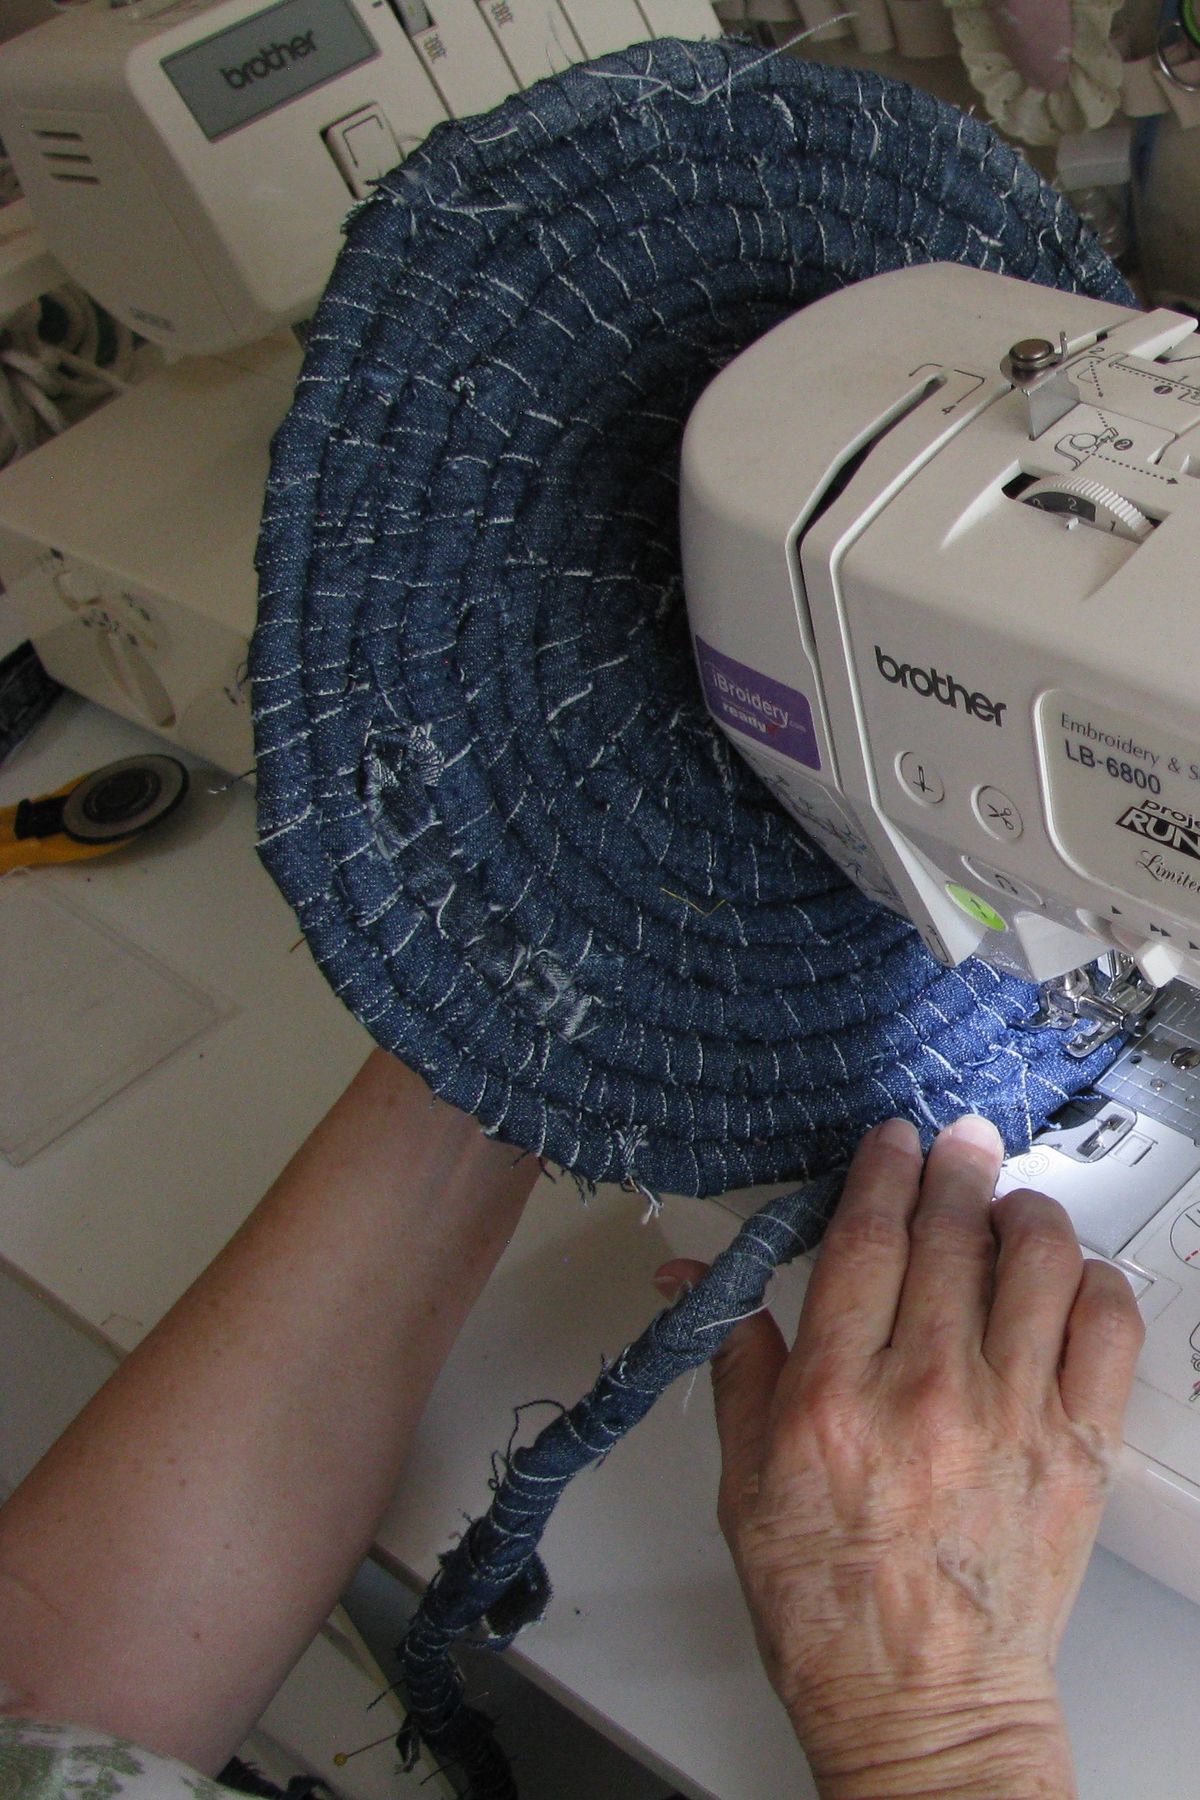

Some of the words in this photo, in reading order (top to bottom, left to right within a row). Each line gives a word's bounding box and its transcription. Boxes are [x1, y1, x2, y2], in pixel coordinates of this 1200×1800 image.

[219, 30, 316, 90] brother
[1068, 497, 1080, 512] 2
[874, 645, 1008, 727] brother
[1061, 712, 1160, 765] Embroidery
[1168, 756, 1182, 775] &
[1065, 739, 1162, 795] LB-6800
